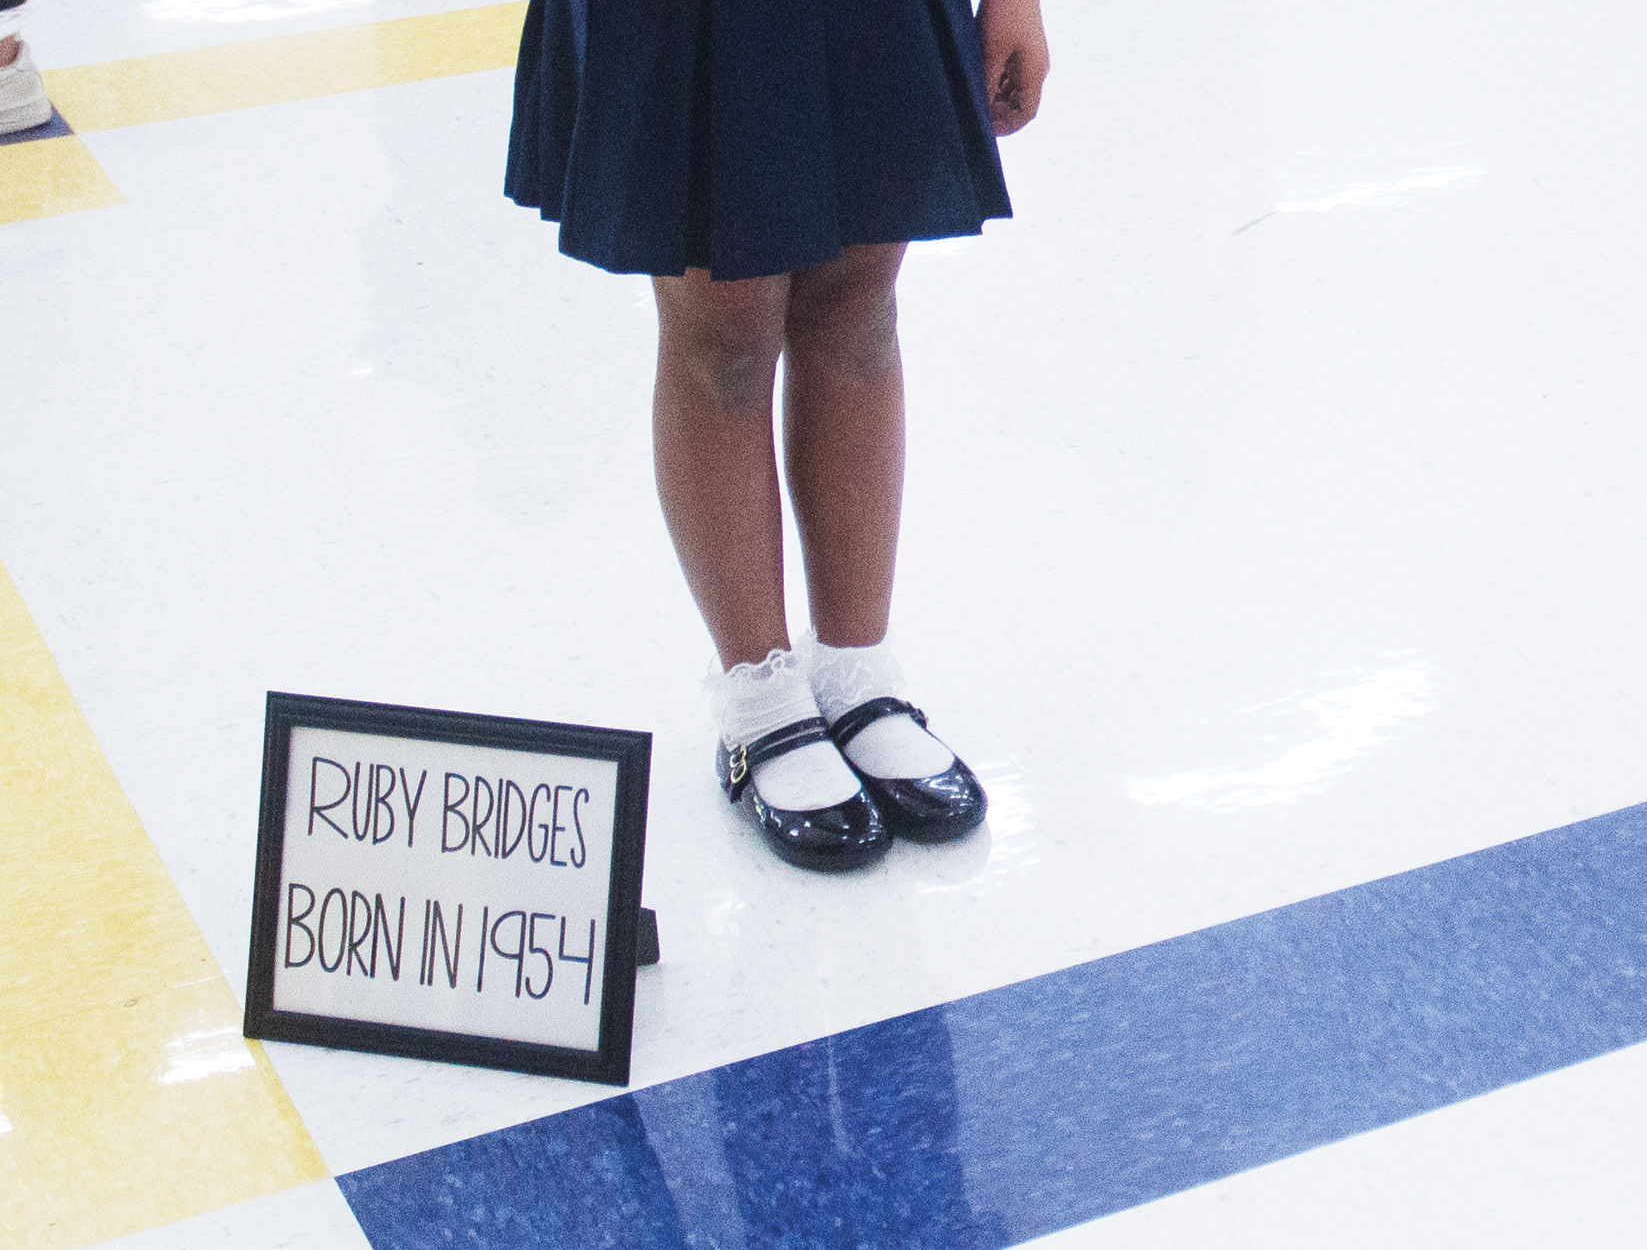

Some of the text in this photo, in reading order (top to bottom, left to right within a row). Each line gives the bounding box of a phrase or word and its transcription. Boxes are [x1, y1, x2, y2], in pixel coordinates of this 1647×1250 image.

[308, 756, 590, 868] RUBY BRIDGES
[284, 882, 596, 1005] BORN IN 1954
